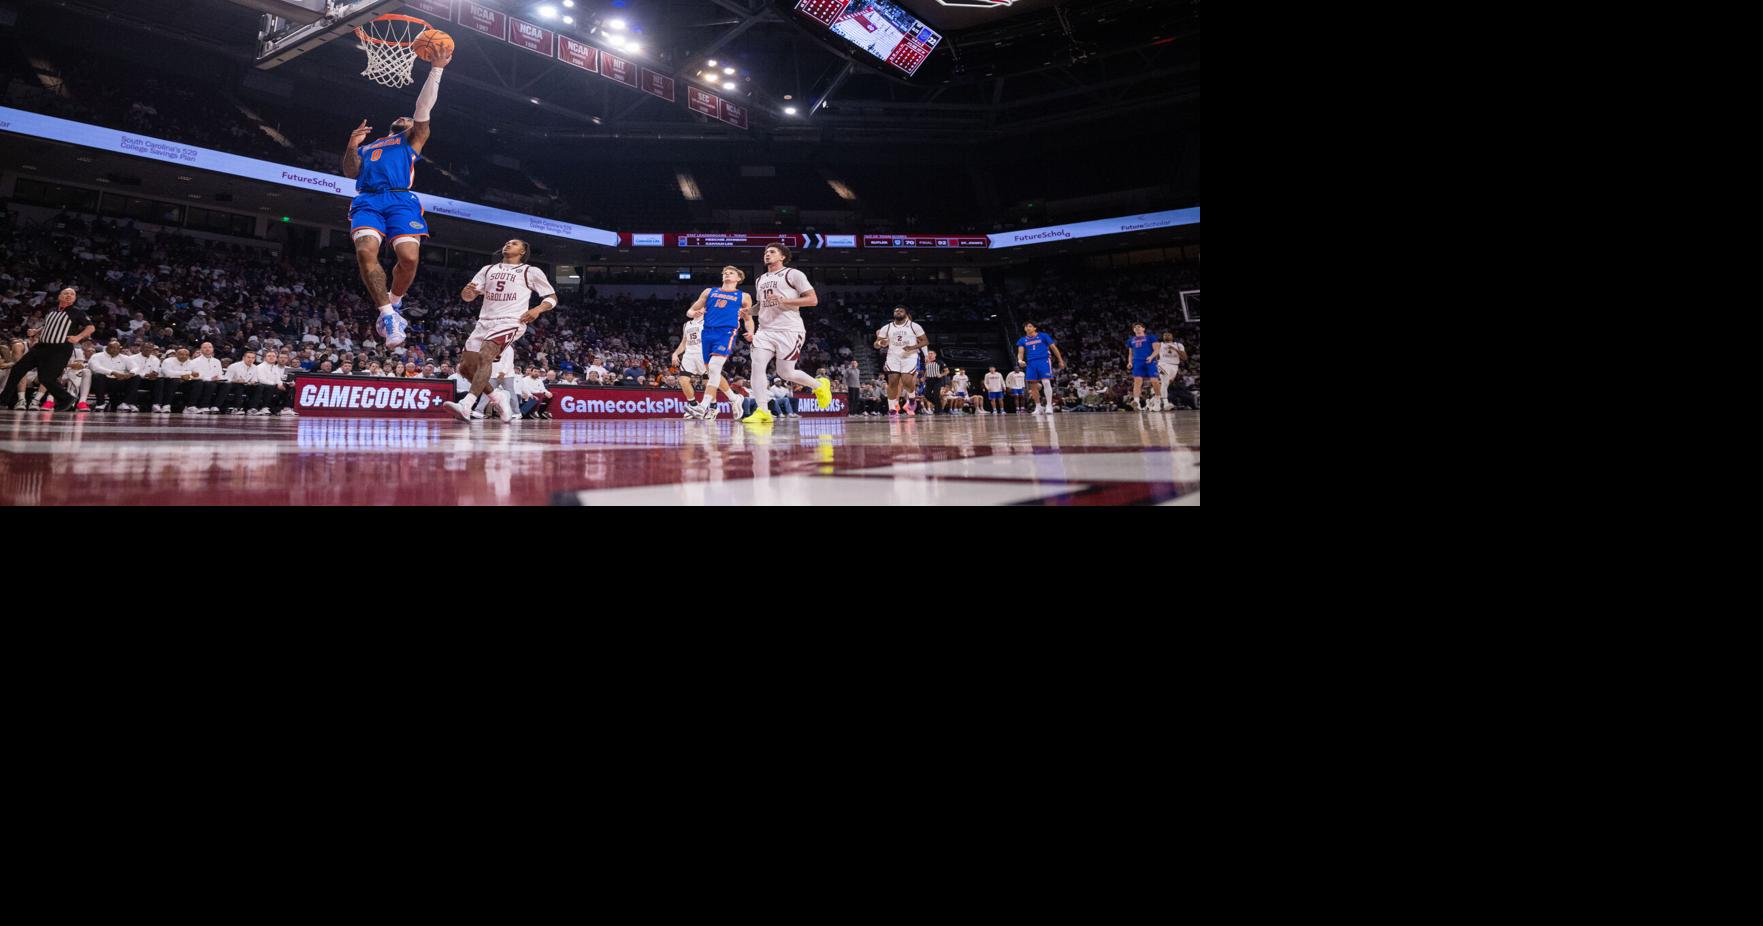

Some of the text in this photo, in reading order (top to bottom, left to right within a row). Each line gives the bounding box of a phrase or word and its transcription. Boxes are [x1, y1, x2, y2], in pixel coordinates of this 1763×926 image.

[470, 5, 495, 22] NCAA
[519, 22, 543, 40] NCAA
[567, 40, 588, 56] NCAA
[613, 58, 625, 70] NIT
[120, 135, 198, 157] South Carolina's 529
[180, 154, 196, 162] Plan
[370, 149, 383, 162] 0
[281, 171, 341, 193] FutureSchola
[1014, 228, 1071, 241] FutureSchola
[490, 272, 517, 283] SOUTH
[496, 281, 506, 292] 5
[299, 384, 443, 410] GAMECOCKS+
[560, 395, 731, 413] GamecocksPlum
